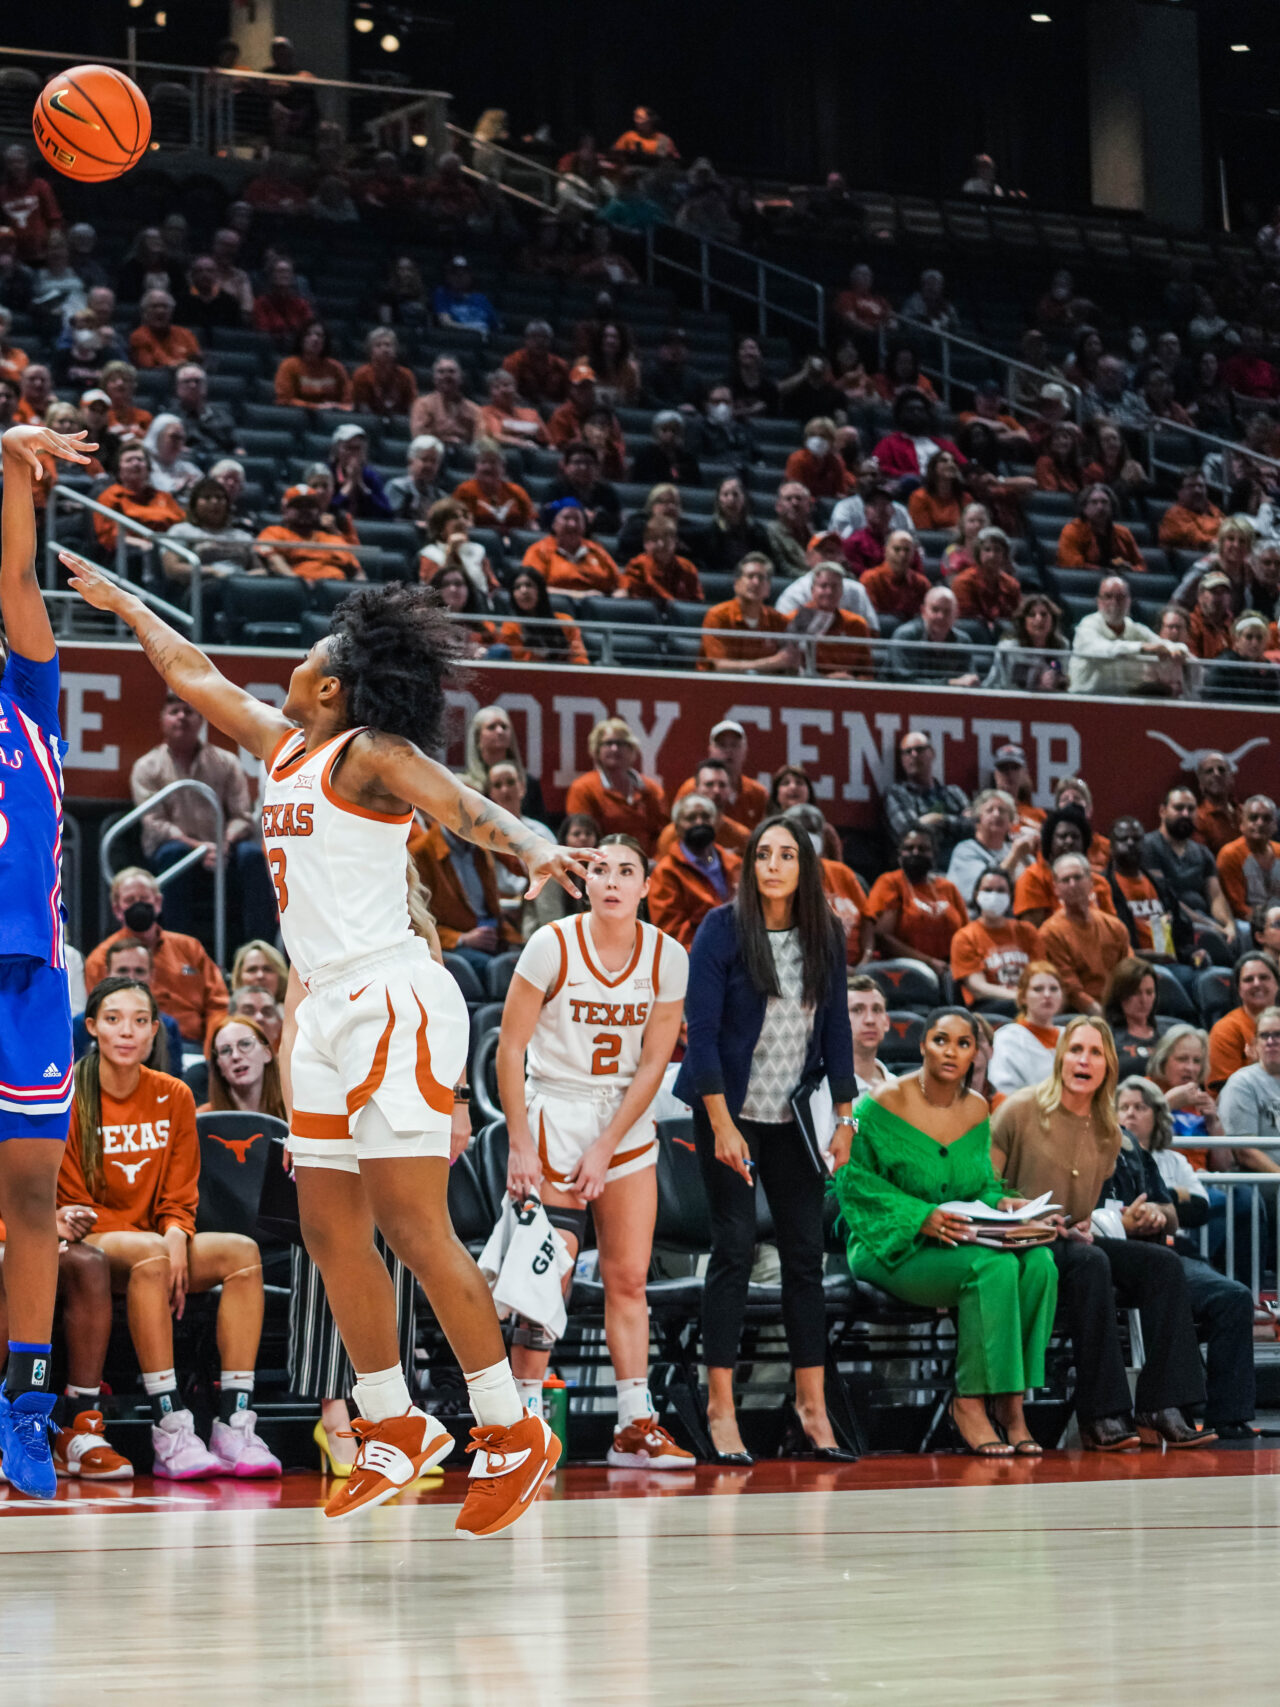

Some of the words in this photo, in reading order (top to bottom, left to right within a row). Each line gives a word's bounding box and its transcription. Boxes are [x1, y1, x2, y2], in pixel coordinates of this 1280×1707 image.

[262, 803, 314, 838] EXAS
[569, 998, 649, 1026] TEXAS
[591, 1032, 623, 1076] 2
[97, 1119, 171, 1155] EXAS
